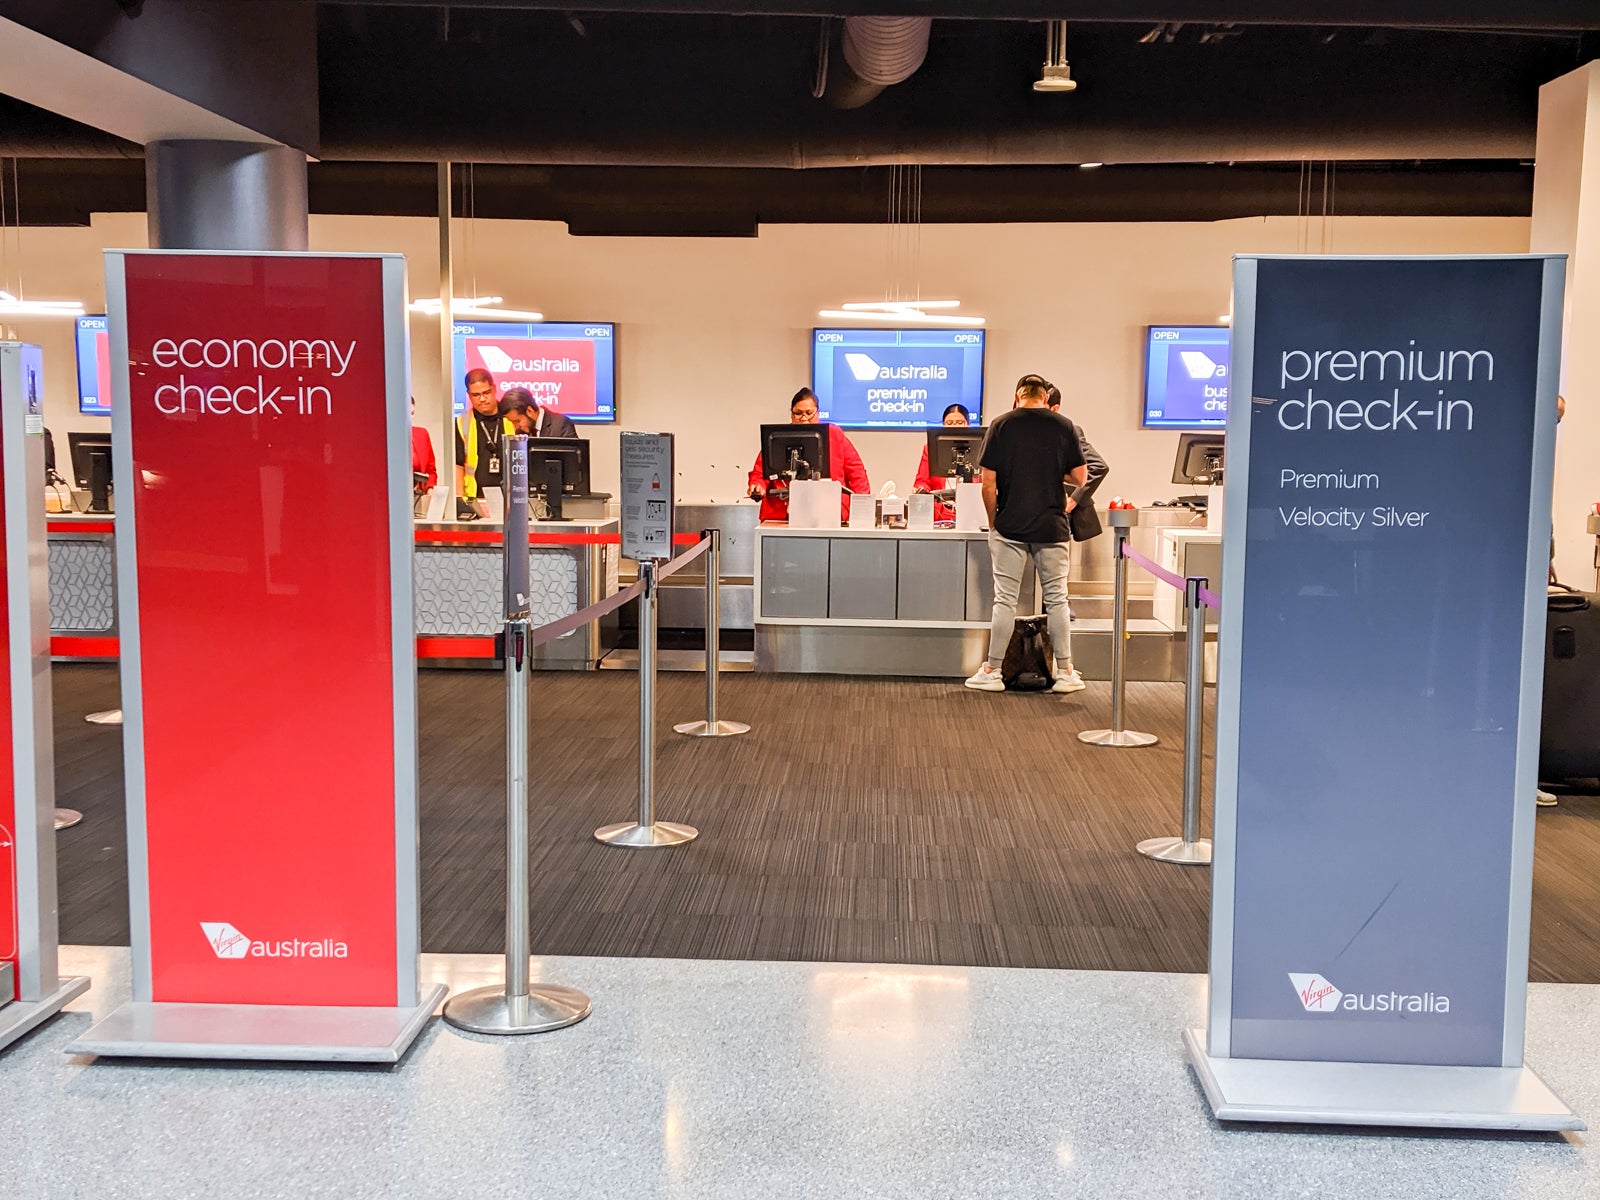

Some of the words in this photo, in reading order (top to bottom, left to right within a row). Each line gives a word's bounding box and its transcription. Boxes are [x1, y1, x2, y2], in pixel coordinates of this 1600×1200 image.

[80, 319, 105, 328] OPEN
[585, 327, 610, 336] OPEN
[818, 333, 843, 342] OPEN
[954, 334, 980, 343] OPEN
[1153, 331, 1180, 340] OPEN
[152, 338, 357, 377] economy
[512, 357, 579, 372] australia
[1281, 339, 1494, 390] premium
[879, 364, 947, 379] australia
[154, 374, 332, 415] check-in
[867, 386, 927, 401] premium
[870, 399, 925, 413] check-in
[1278, 388, 1473, 431] check-in
[1281, 469, 1379, 489] Premium
[1279, 506, 1366, 530] Velocity
[1372, 506, 1430, 527] Silver
[213, 928, 245, 956] Virgin
[251, 938, 348, 958] australia
[1301, 979, 1336, 1009] Virgin
[1343, 991, 1450, 1013] australia
